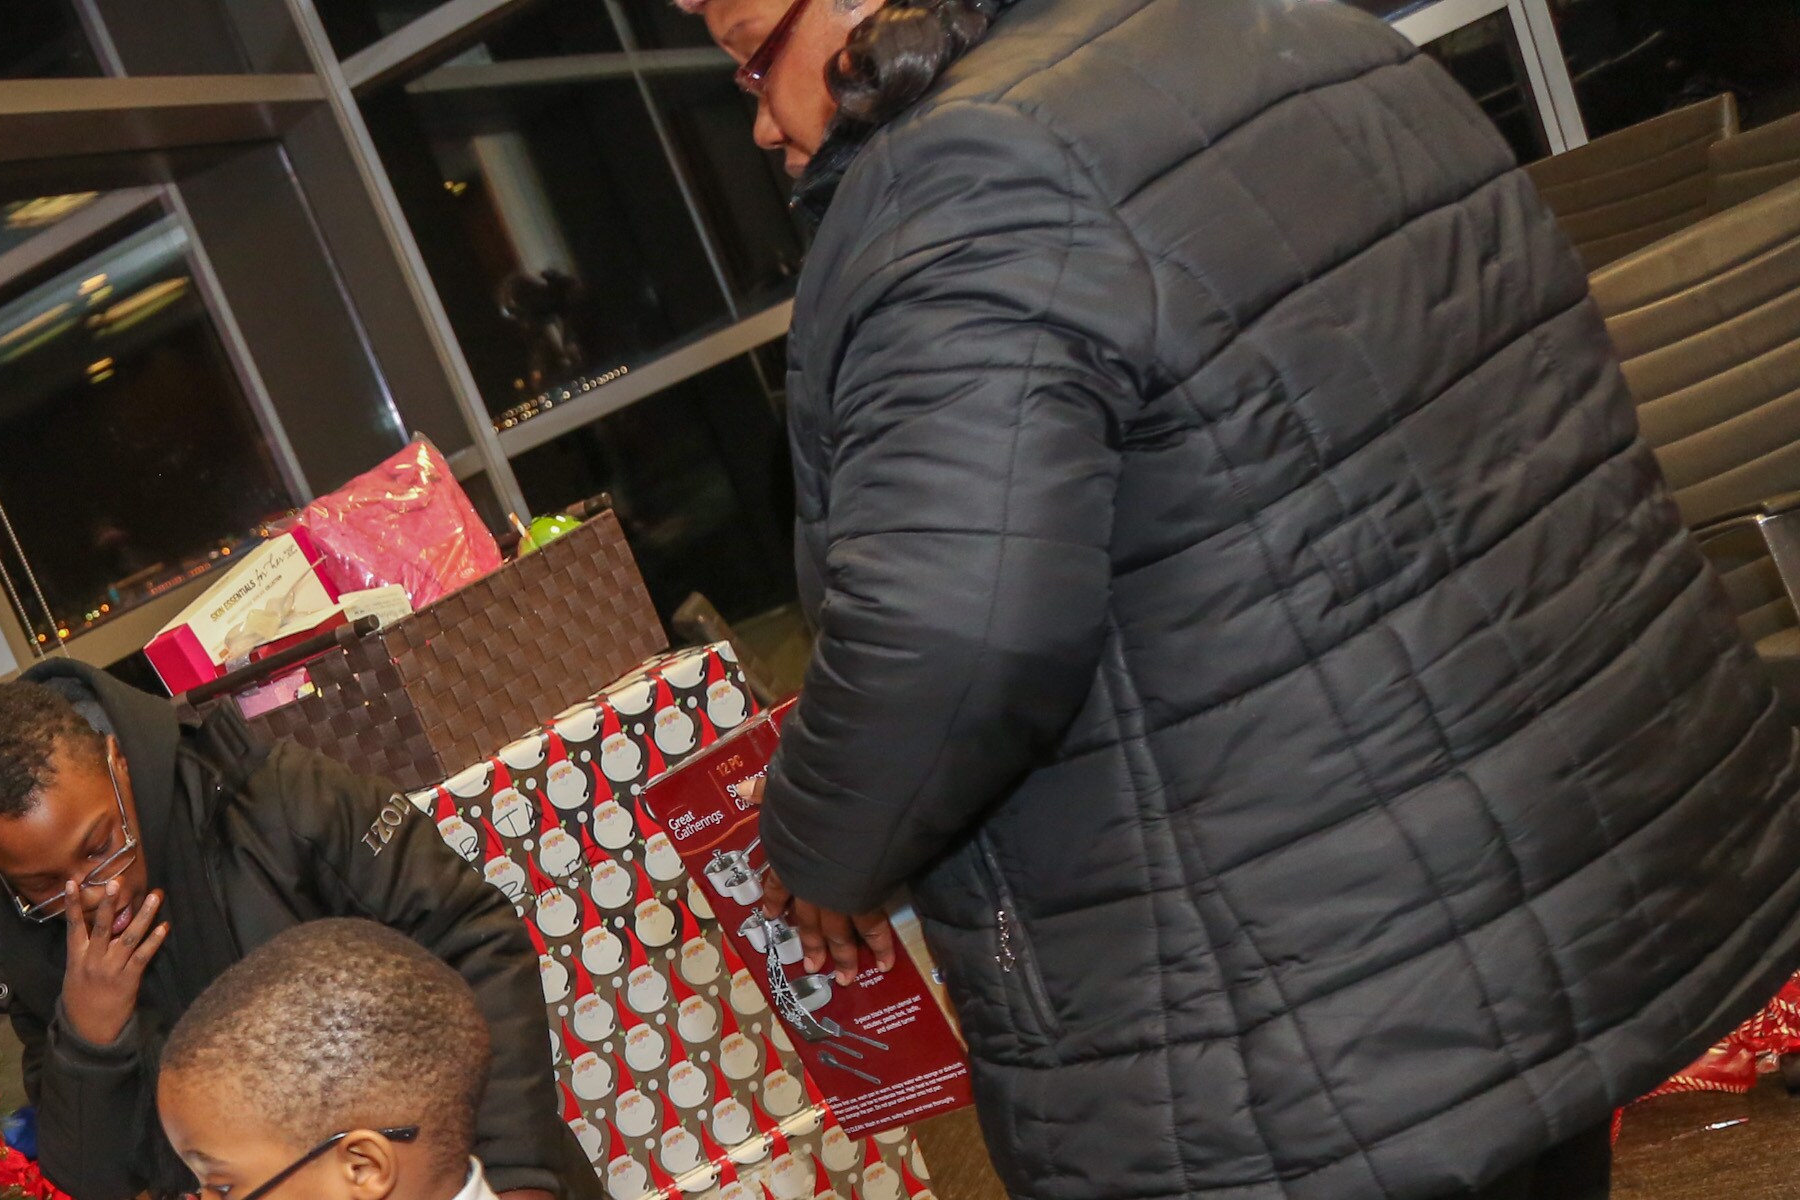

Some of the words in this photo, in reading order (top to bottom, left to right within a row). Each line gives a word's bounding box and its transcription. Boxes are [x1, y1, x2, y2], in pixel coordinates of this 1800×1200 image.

[209, 605, 225, 622] SKIN
[222, 579, 256, 610] ESSENTIALS
[715, 761, 730, 777] 12
[727, 753, 744, 771] PC
[360, 791, 410, 856] IZOD
[667, 809, 695, 831] Great
[673, 808, 723, 840] Gatherings
